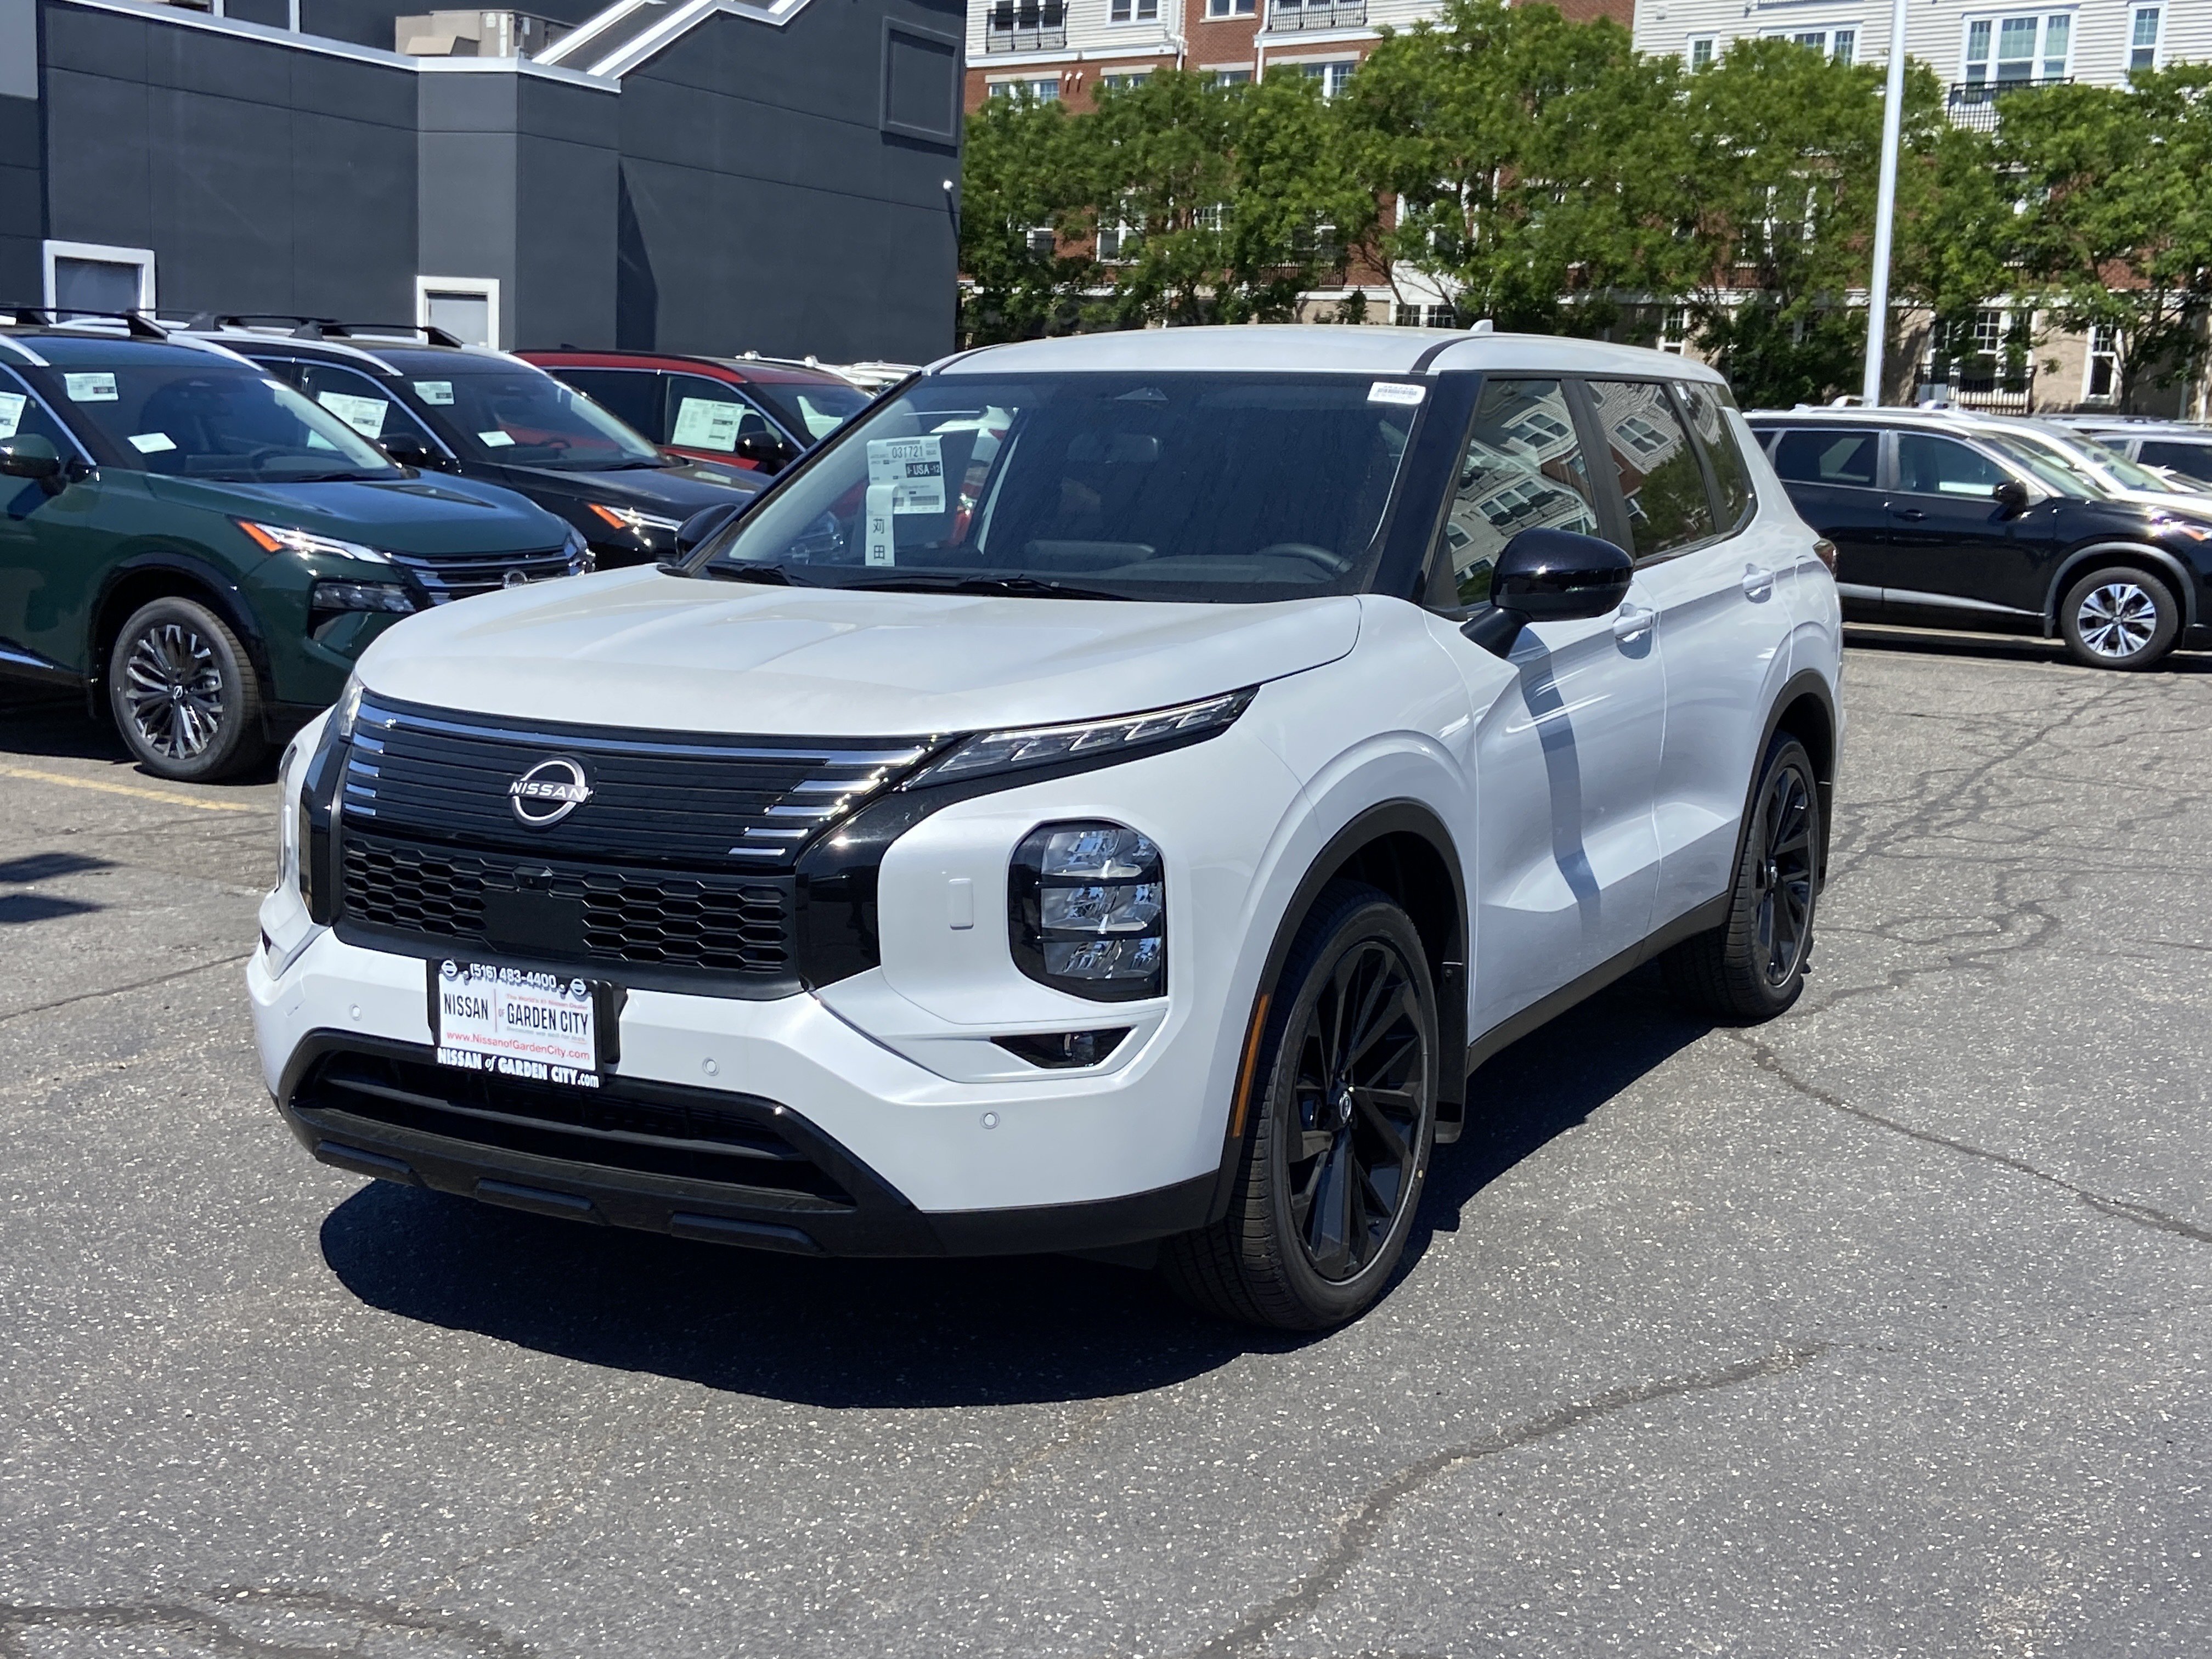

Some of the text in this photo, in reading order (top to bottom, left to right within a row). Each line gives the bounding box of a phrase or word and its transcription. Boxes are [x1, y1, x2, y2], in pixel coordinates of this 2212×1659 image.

[891, 445, 923, 459] 031721
[509, 781, 586, 800] NISSAN
[470, 963, 557, 988] (516) 483-4400
[444, 993, 489, 1020] NISSAN
[507, 1003, 557, 1031] GARDEN
[560, 1010, 589, 1035] CITY
[446, 1031, 590, 1060] www.NissanofGardenCity.com
[437, 1047, 600, 1088] NISSAN of GARDEN CITY.com
